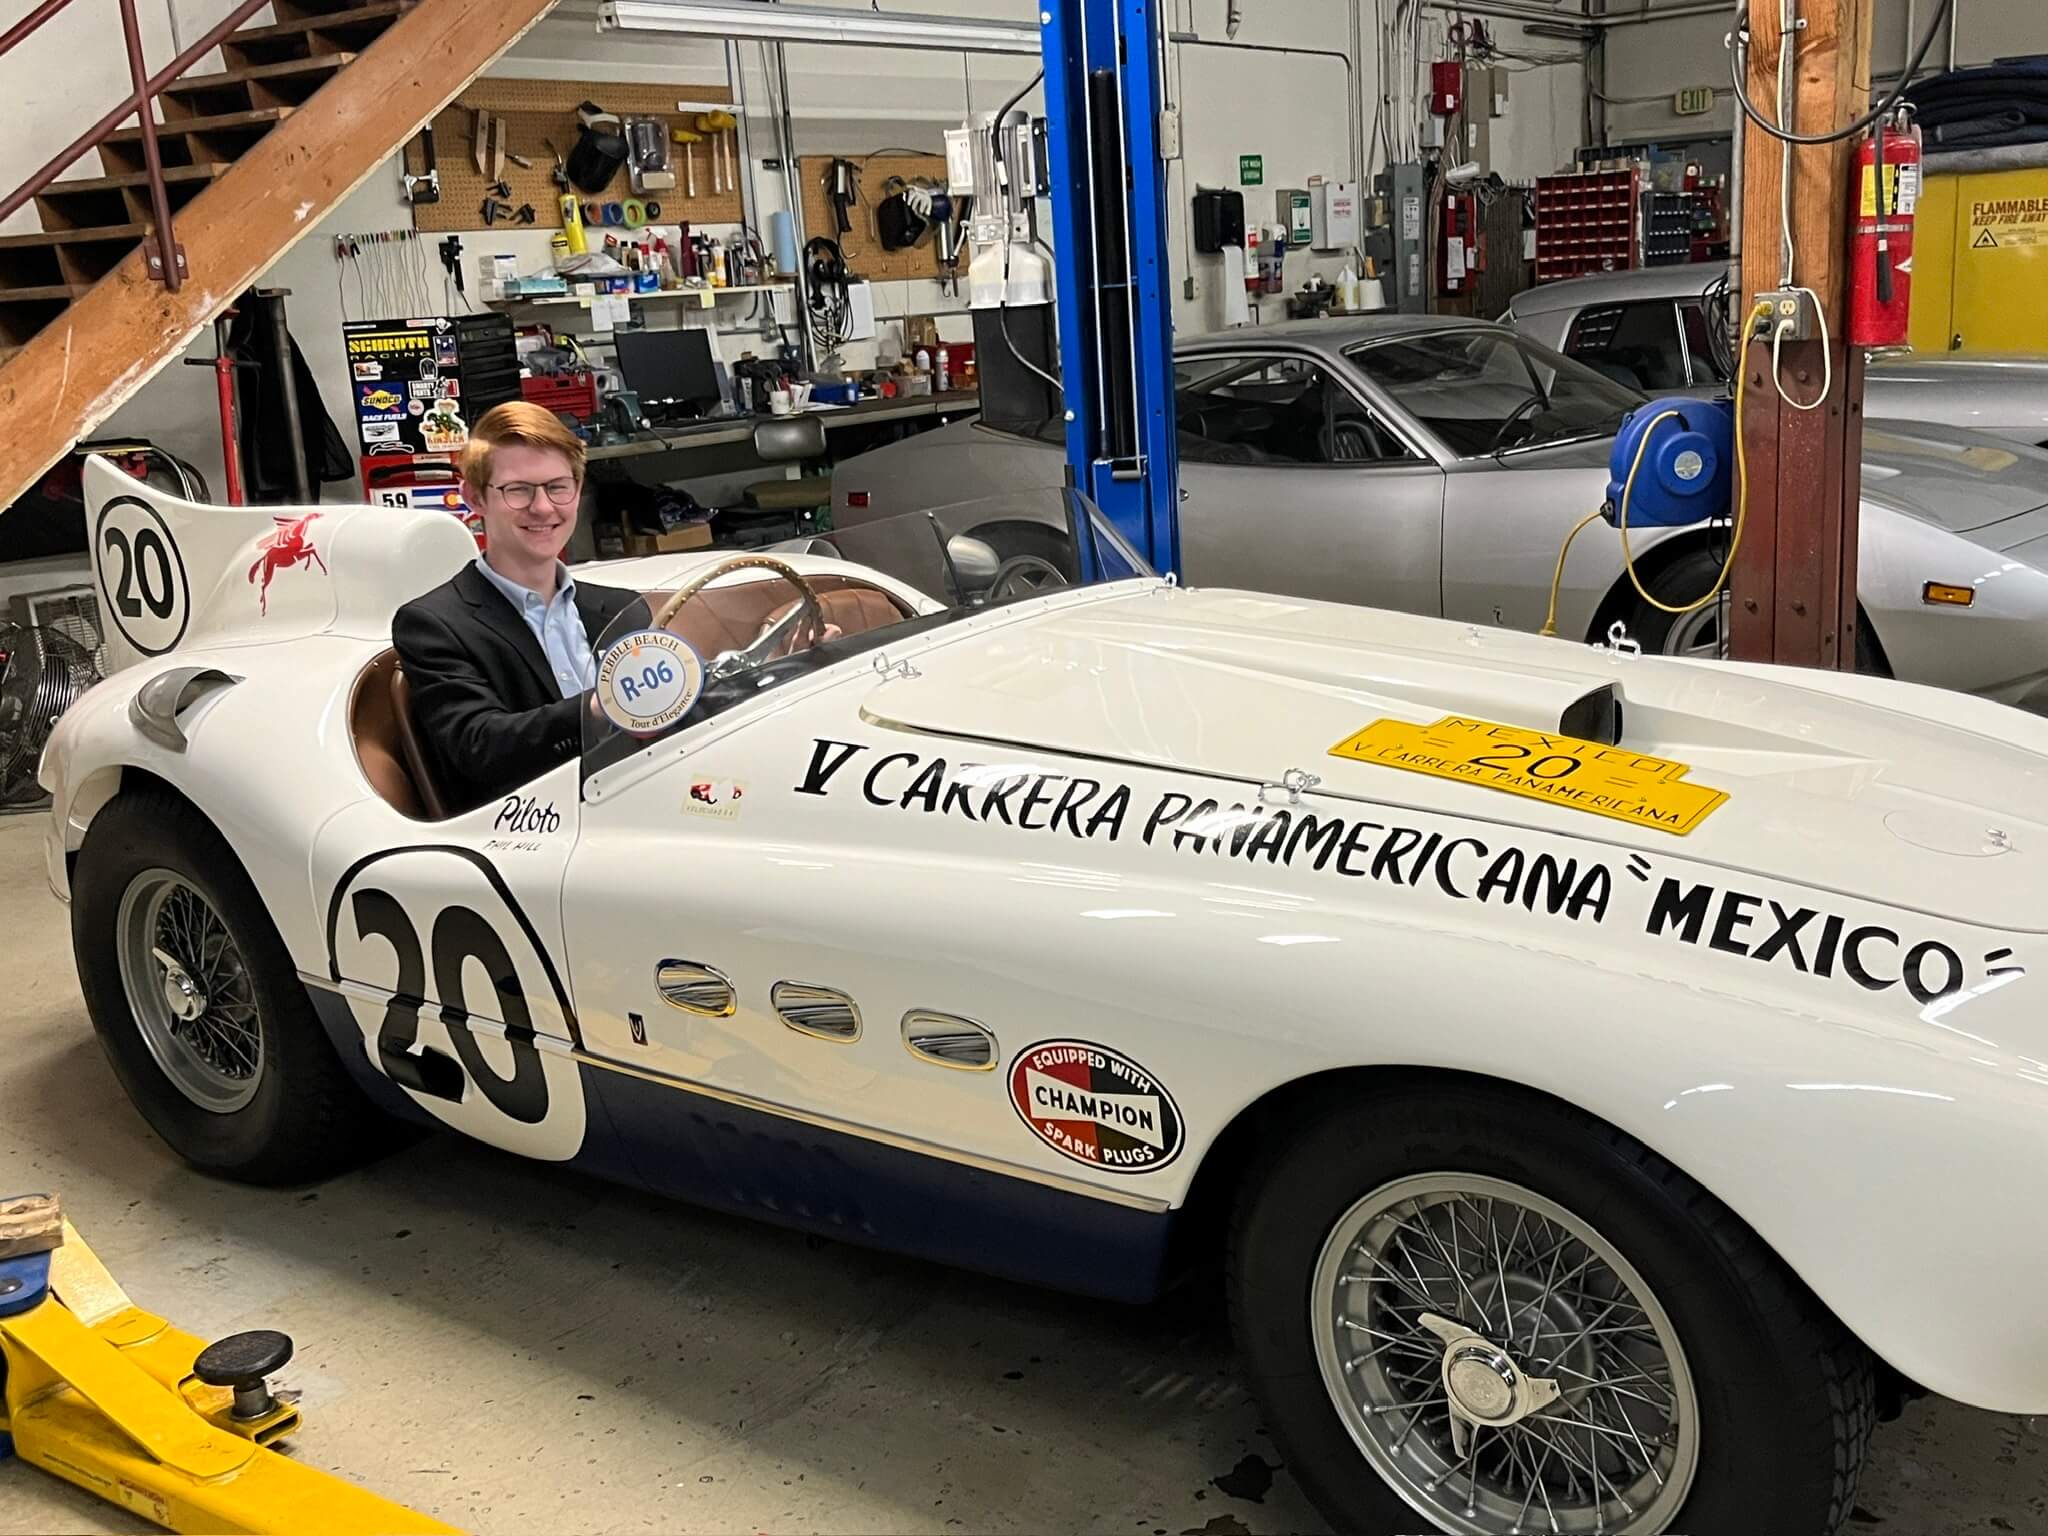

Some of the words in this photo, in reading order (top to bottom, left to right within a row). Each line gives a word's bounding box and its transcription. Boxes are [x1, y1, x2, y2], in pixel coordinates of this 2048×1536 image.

[1681, 89, 1707, 111] EXIT
[1972, 215, 1997, 226] KEEP
[1998, 214, 2018, 225] FIRE
[2020, 213, 2047, 224] AWAY
[1973, 198, 2048, 215] FLAMMABLE
[349, 336, 430, 353] SCHROTH
[350, 351, 431, 361] RACING
[363, 394, 401, 406] SUNOCO
[384, 413, 407, 421] FUELS
[382, 492, 408, 508] 59
[104, 527, 174, 619] 20
[601, 640, 633, 683] PEBBLE
[634, 634, 680, 652] BEACH
[620, 660, 673, 702] R-06
[630, 719, 650, 729] Tour
[1446, 720, 1667, 773] MEXICO
[1470, 743, 1582, 780] 20
[1354, 742, 1373, 752] V
[1377, 748, 1483, 777] CARRERA
[1493, 772, 1679, 825] PANAMERICANA
[494, 795, 560, 834] Piloto
[794, 738, 870, 796] V
[861, 753, 1131, 842] CARRERA
[1143, 791, 1612, 924] PANAMERICANA
[351, 888, 550, 1124] 20
[1032, 1049, 1106, 1070] EQUIPPED
[1110, 1060, 1151, 1094] WITH
[1035, 1086, 1153, 1131] CHAMPION
[1044, 1122, 1097, 1159] SPARK
[1103, 1145, 1155, 1164] PLUGS
